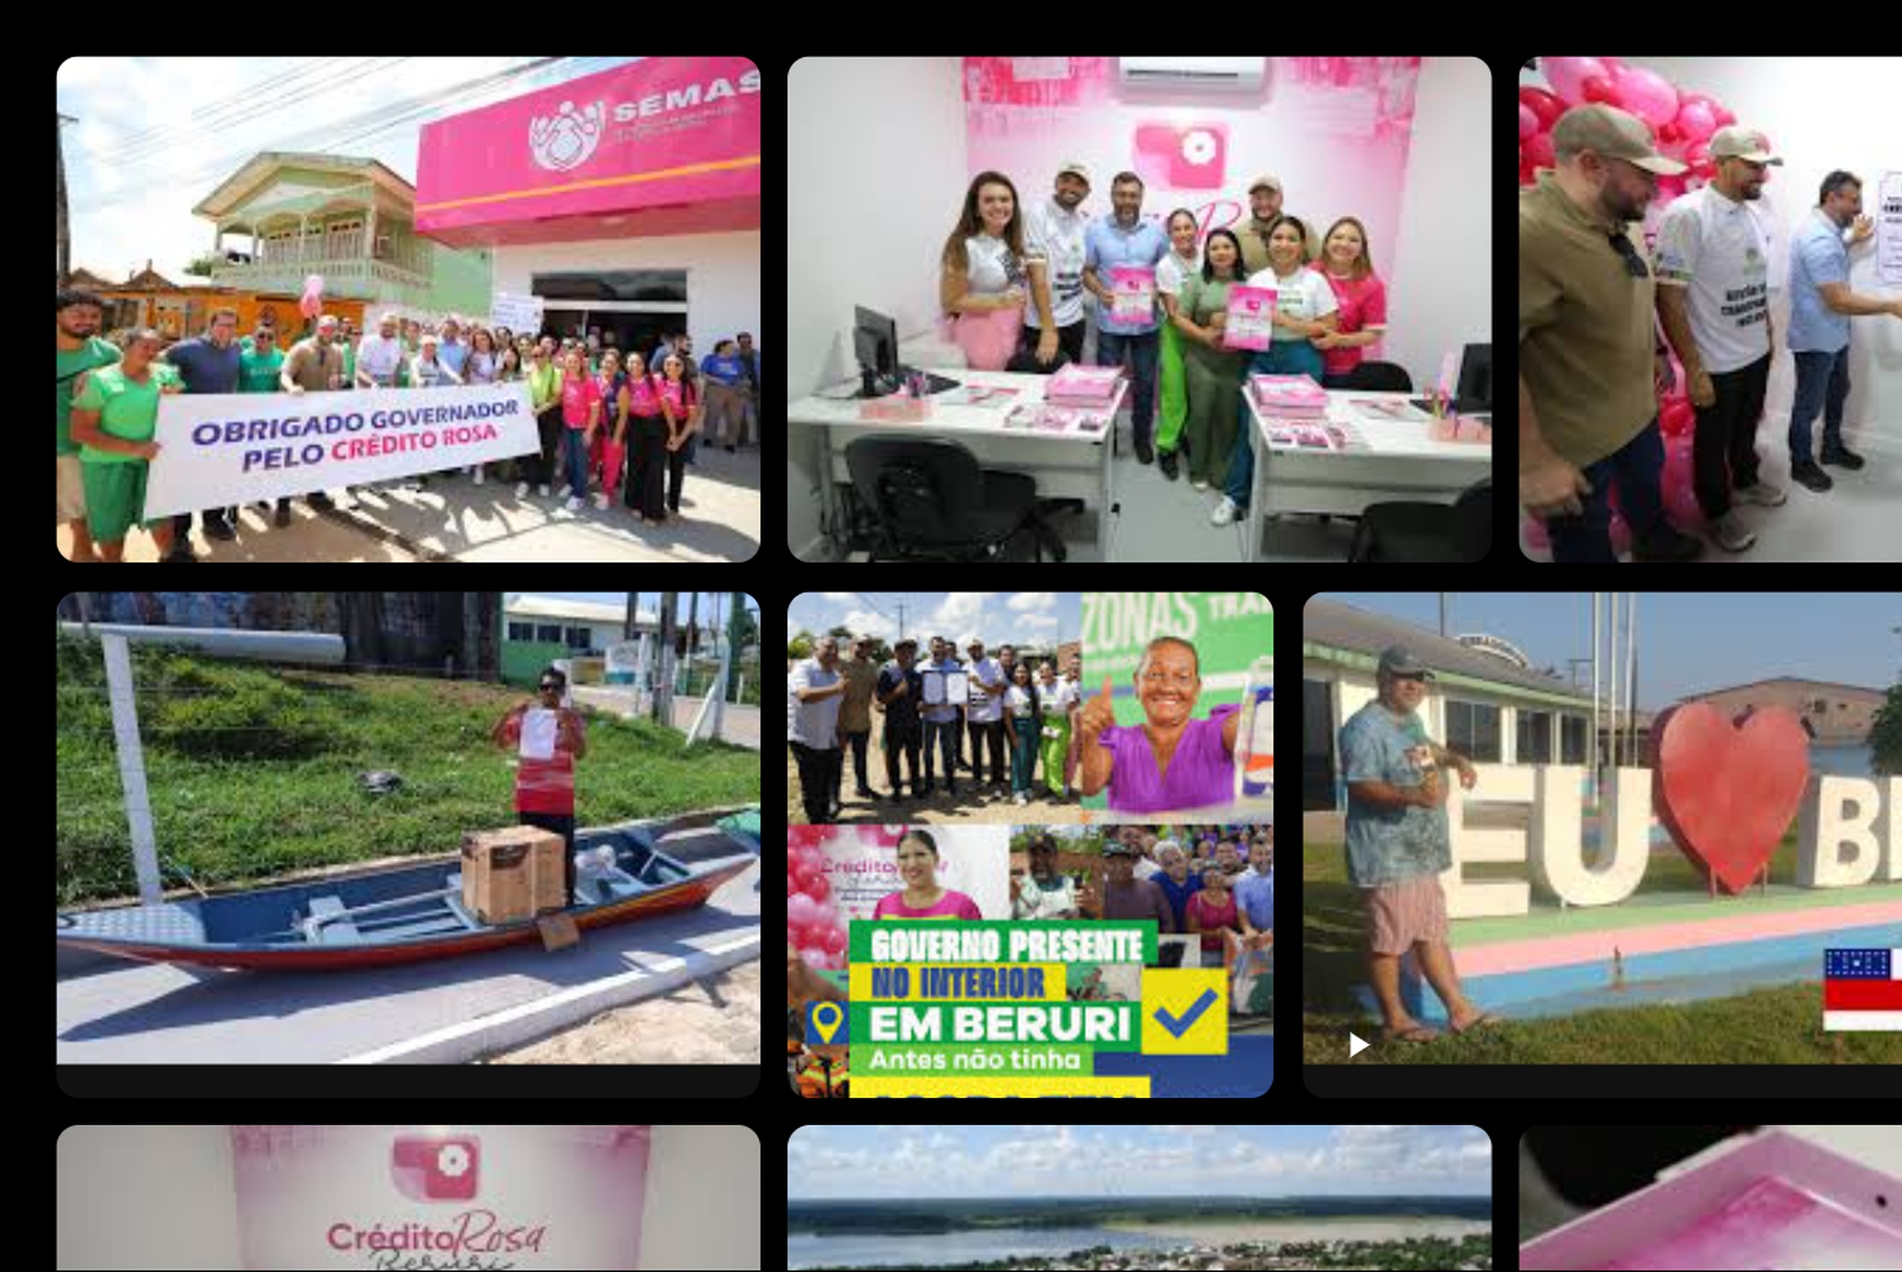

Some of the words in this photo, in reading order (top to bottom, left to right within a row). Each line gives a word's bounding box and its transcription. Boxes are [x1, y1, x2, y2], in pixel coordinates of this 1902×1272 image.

[613, 69, 761, 123] SEMAS
[192, 412, 364, 446] OBRIGADO
[370, 399, 519, 429] GOVERNADOR
[242, 444, 324, 473] PELO
[331, 426, 437, 461] CRÉDITO
[442, 424, 498, 446] ROSA
[1446, 763, 1654, 918] EU
[327, 1223, 454, 1251] Crédito
[452, 1209, 547, 1257] Rosa
